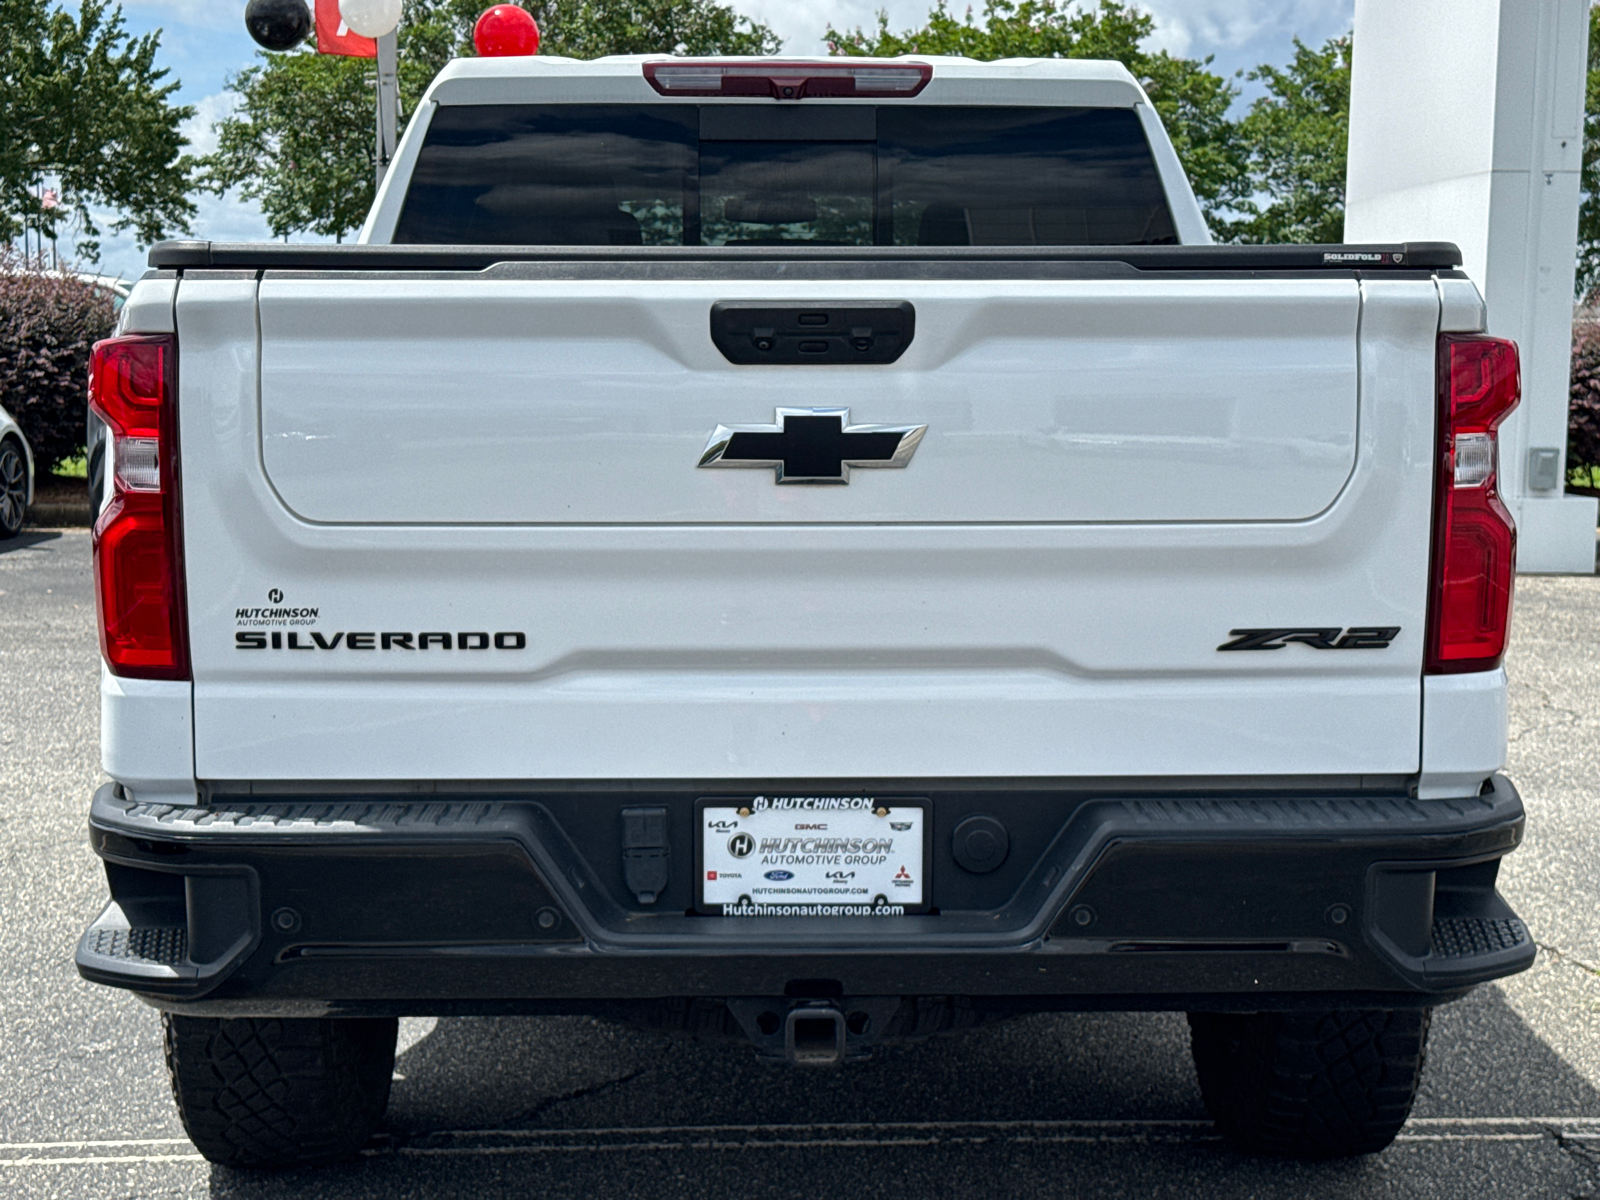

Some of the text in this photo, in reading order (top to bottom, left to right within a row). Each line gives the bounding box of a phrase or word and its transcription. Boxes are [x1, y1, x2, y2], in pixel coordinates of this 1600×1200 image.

[235, 608, 320, 618] HUTCHINSON
[235, 631, 526, 650] SILVERADO
[1216, 626, 1402, 651] ZR2
[771, 797, 874, 810] HUTCHINSON
[758, 838, 893, 854] HUTCHINSON
[760, 855, 887, 865] AUTOMOTIVE GROUP
[722, 904, 904, 916] Hutchinsonautogroup.com
